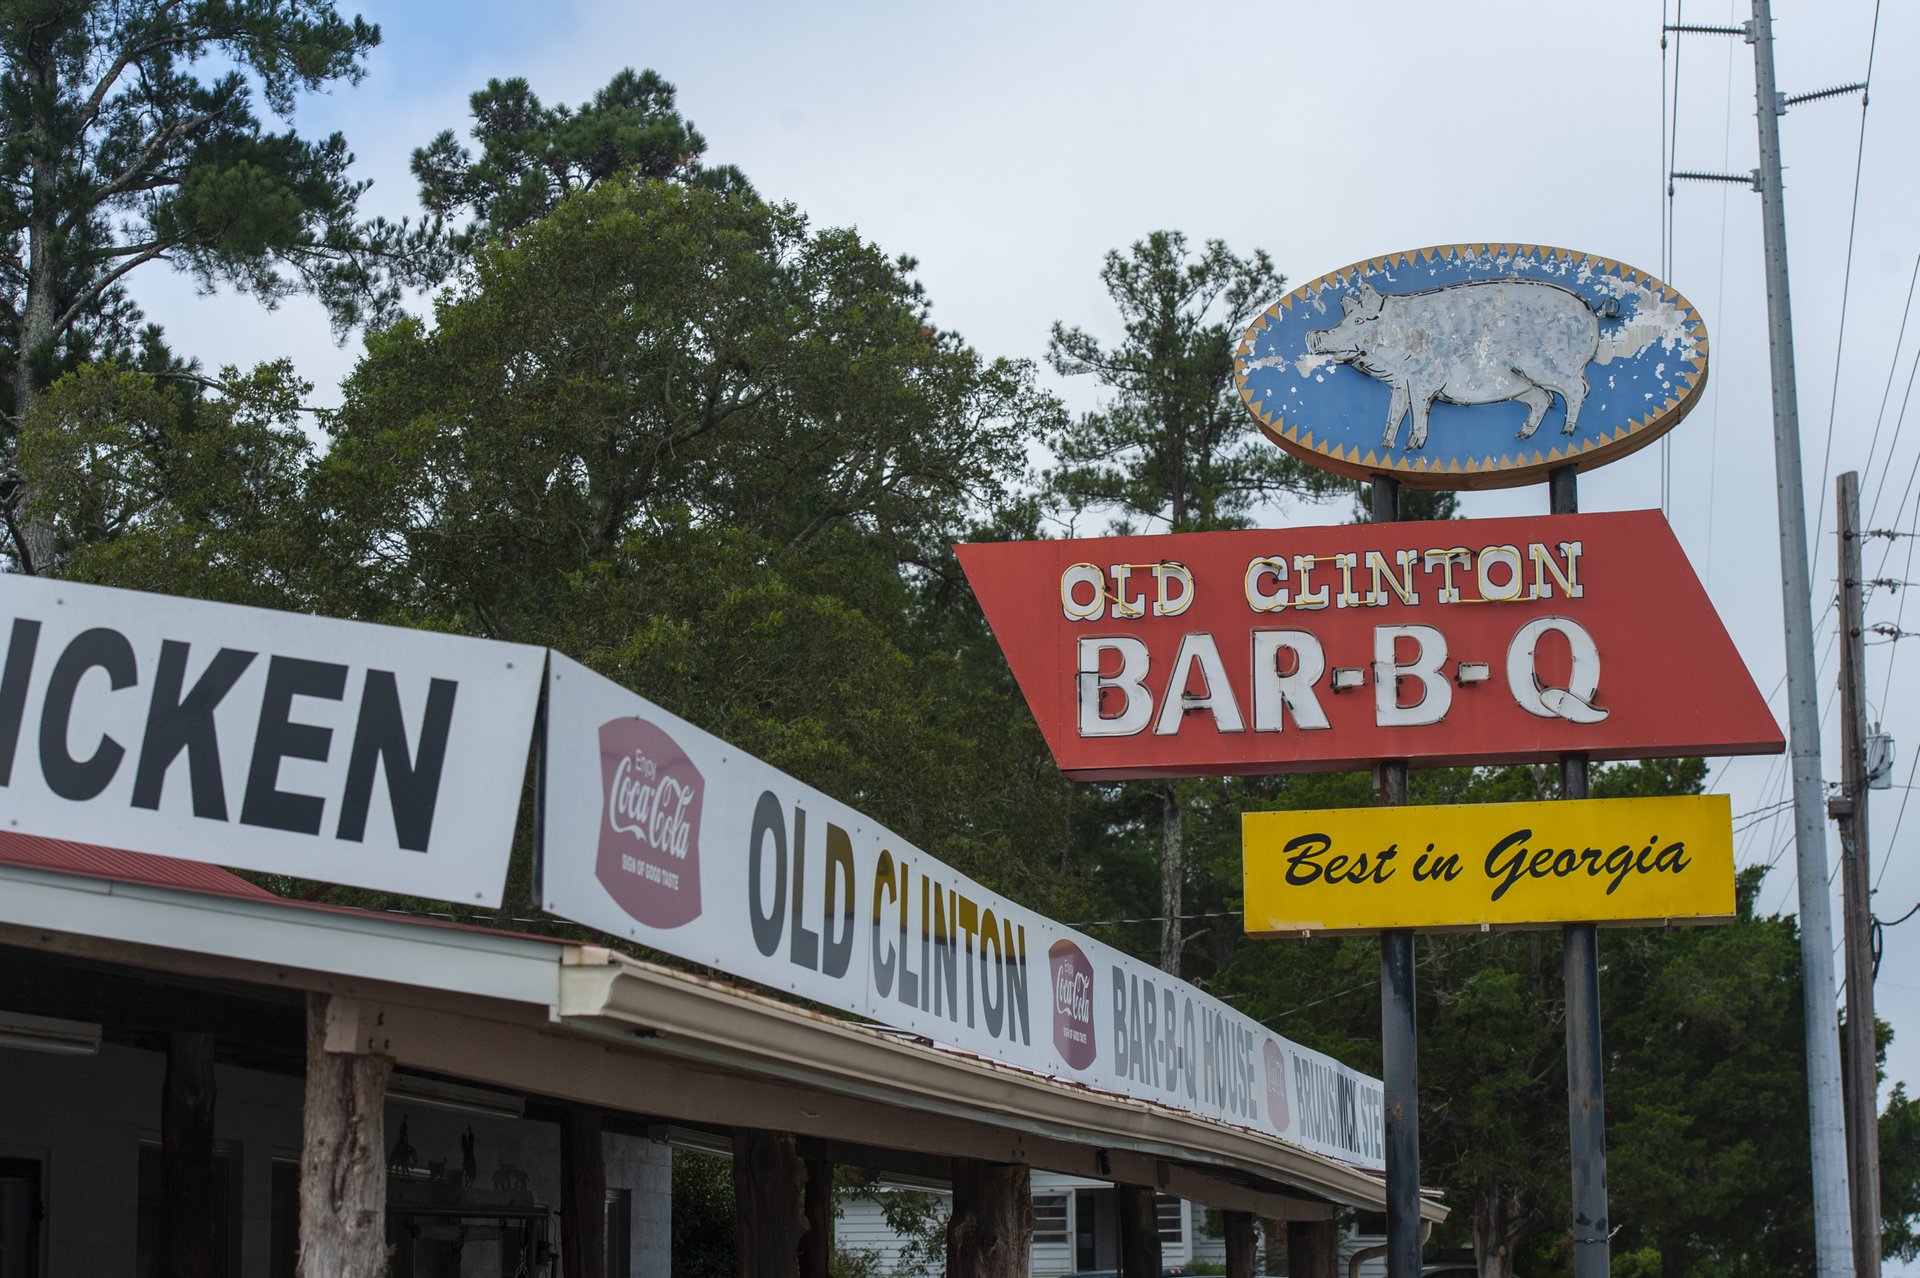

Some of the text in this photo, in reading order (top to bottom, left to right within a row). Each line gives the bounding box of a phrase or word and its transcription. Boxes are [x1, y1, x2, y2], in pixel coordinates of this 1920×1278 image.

[1060, 540, 1584, 622] OLD CLINTON
[1076, 615, 1611, 738] BAR-B-Q
[0, 617, 459, 853] ICKEN
[635, 749, 657, 781] Enjoy
[610, 756, 694, 860] Coca-Cola
[1283, 828, 1692, 902] Best in Georgia
[748, 790, 1031, 1047] OLD CLINTON
[1112, 965, 1258, 1120] BAR-B-Q HOUSE
[1293, 1055, 1360, 1154] BRUNSWICK
